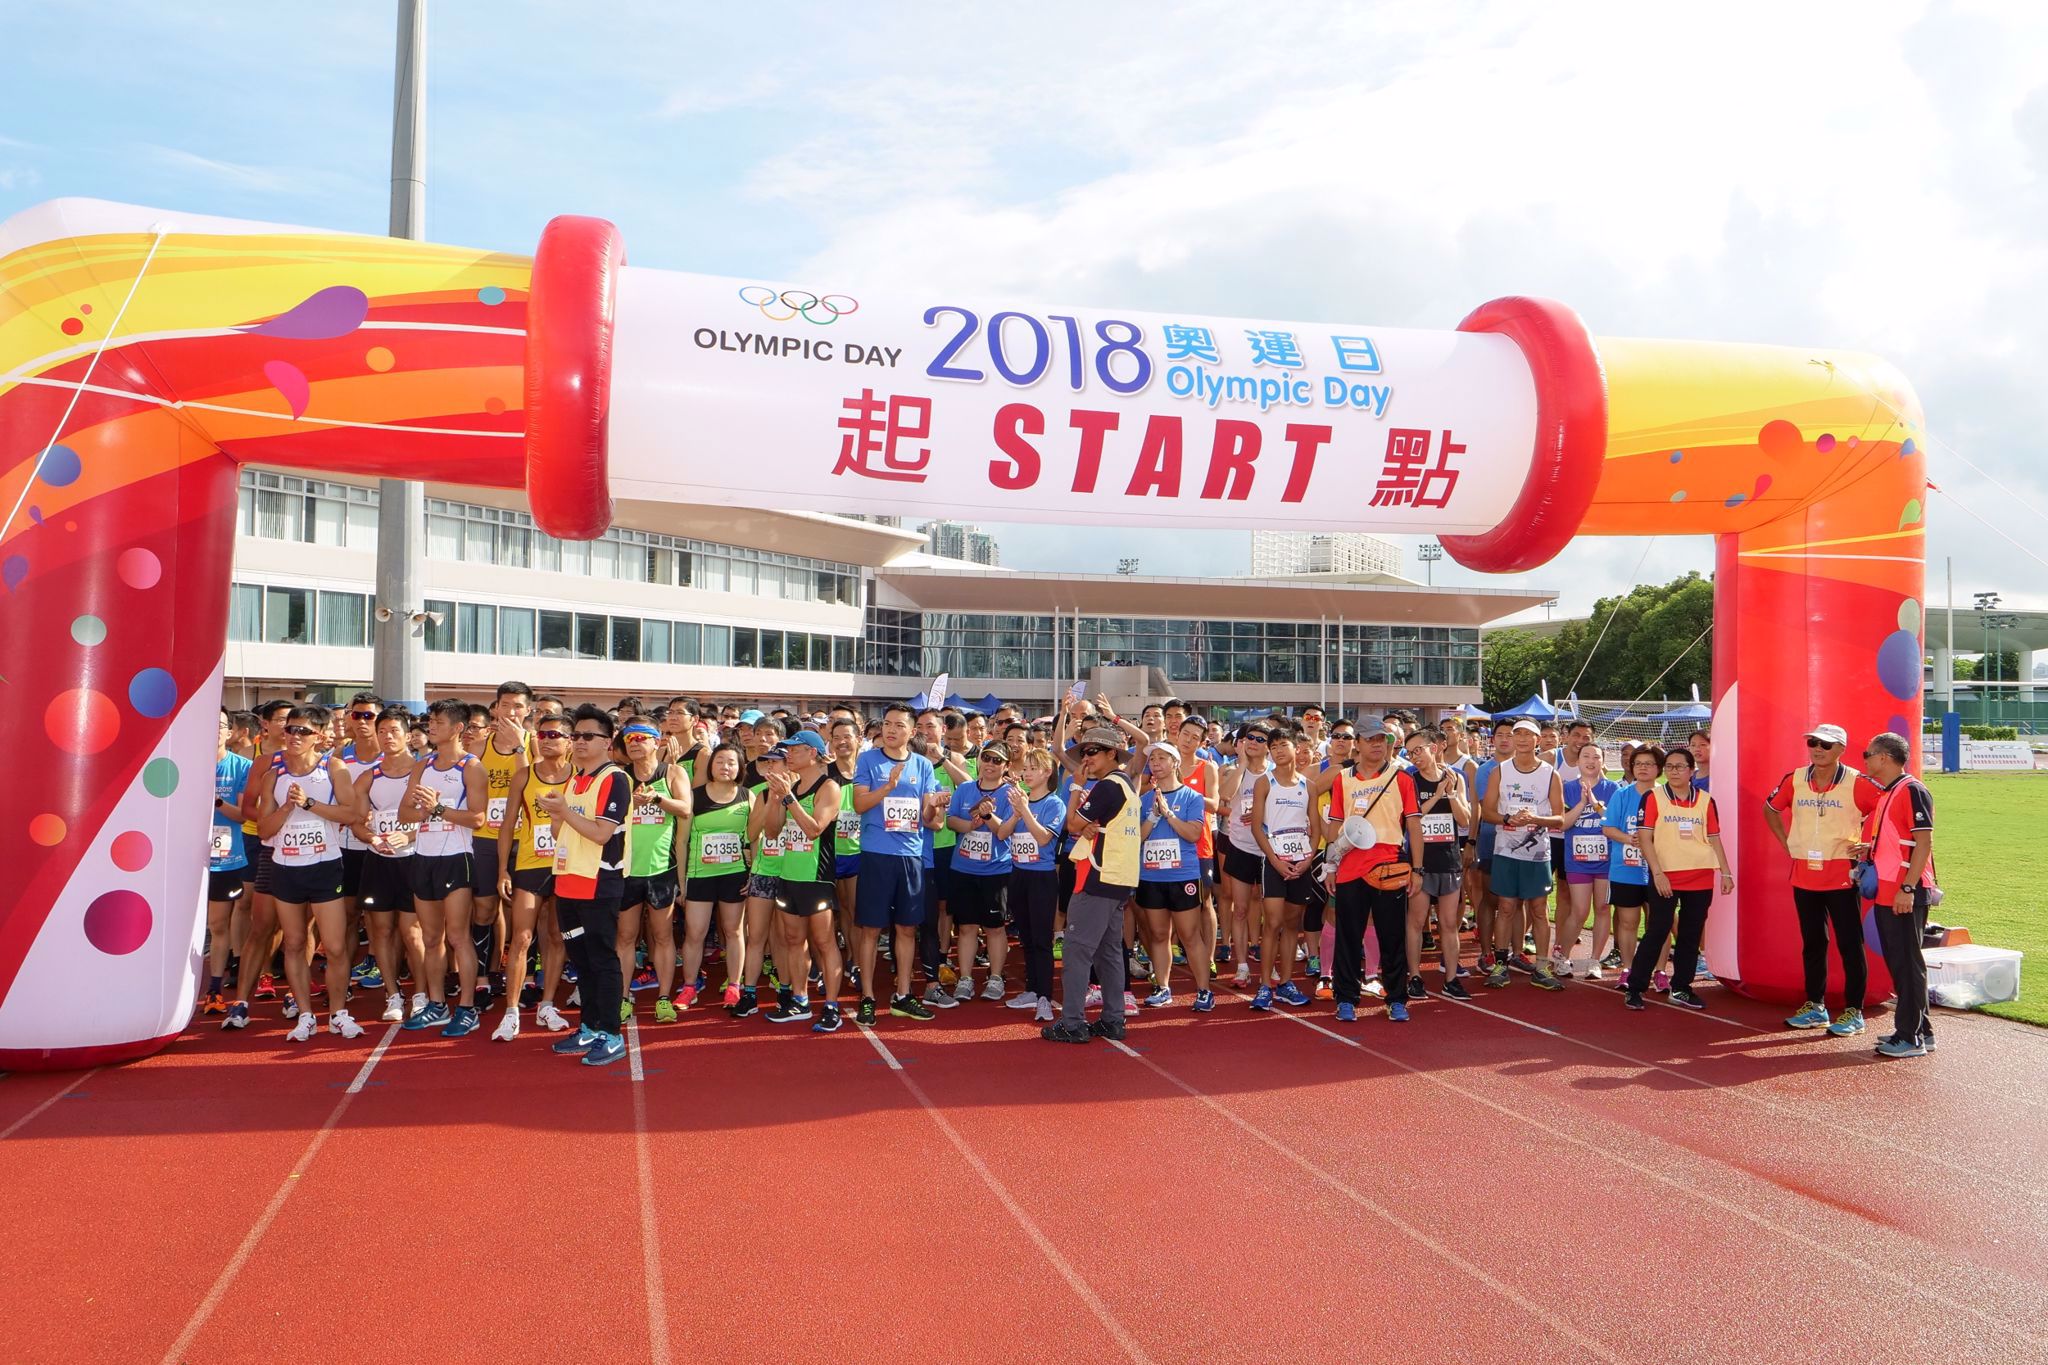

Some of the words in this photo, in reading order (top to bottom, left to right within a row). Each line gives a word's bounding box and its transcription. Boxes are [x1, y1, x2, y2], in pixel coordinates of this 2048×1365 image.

[693, 327, 833, 362] OLYMPIC
[844, 343, 902, 368] DAY
[923, 305, 1152, 394] 2018
[1166, 365, 1311, 409] Olympic
[1324, 375, 1391, 417] Day
[831, 388, 932, 483] 起
[988, 402, 1332, 503] START
[1368, 427, 1467, 509] 點
[1351, 785, 1391, 799] MARSHAL
[634, 803, 662, 815] 1354
[1797, 799, 1843, 808] MARSHAL
[887, 807, 918, 820] C1293
[1421, 823, 1451, 835] C1508
[283, 831, 323, 846] C1256
[962, 838, 989, 852] C1290
[704, 843, 739, 856] C1355
[1283, 842, 1303, 853] 984
[1575, 844, 1605, 854] C1319
[1146, 849, 1177, 861] C1291
